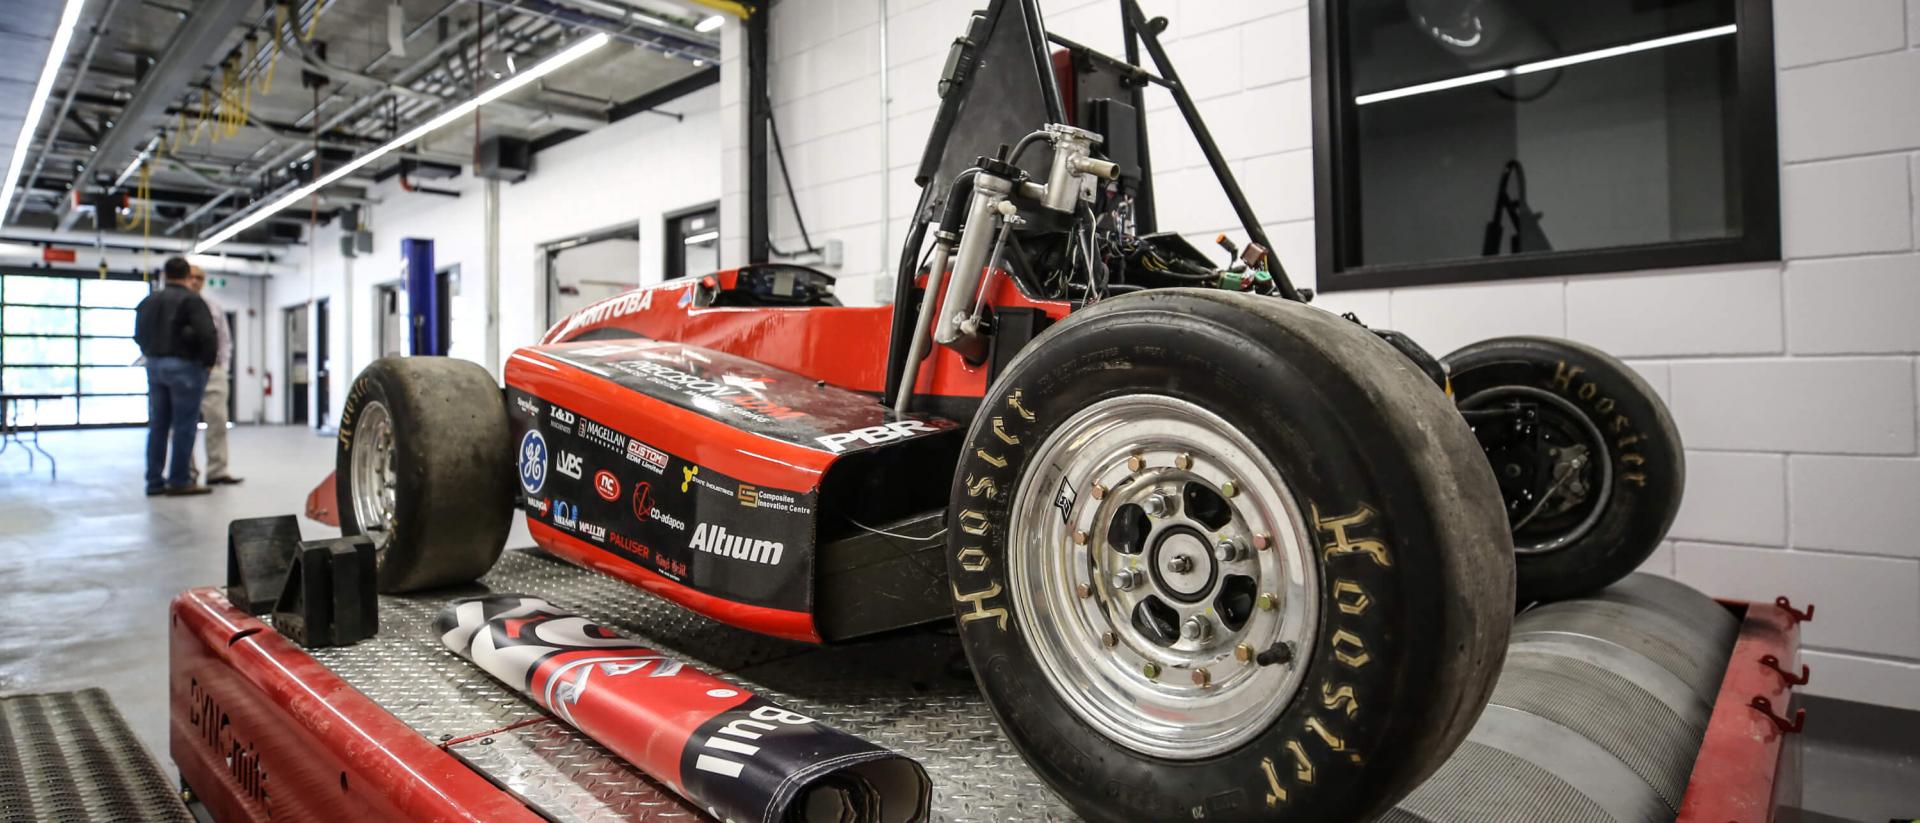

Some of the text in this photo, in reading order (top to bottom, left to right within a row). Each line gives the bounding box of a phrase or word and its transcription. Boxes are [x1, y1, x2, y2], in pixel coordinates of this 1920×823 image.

[618, 358, 742, 396] PRECISION
[550, 405, 575, 425] I&D
[1555, 360, 1648, 488] Hoosier
[587, 421, 626, 449] MAGELLAN
[814, 419, 940, 453] PBR
[626, 453, 664, 475] EDM Limited
[629, 440, 663, 465] CUSTOM
[757, 499, 811, 515] Innovation Centre
[758, 490, 795, 504] Composites
[952, 387, 1037, 632] Hoosier
[578, 520, 606, 539] WALLIN
[650, 507, 685, 531] CD-adapco
[609, 531, 650, 560] PALLISER
[688, 522, 784, 566] Altium
[1260, 499, 1393, 807] Hoosier
[696, 705, 818, 779] Bull
